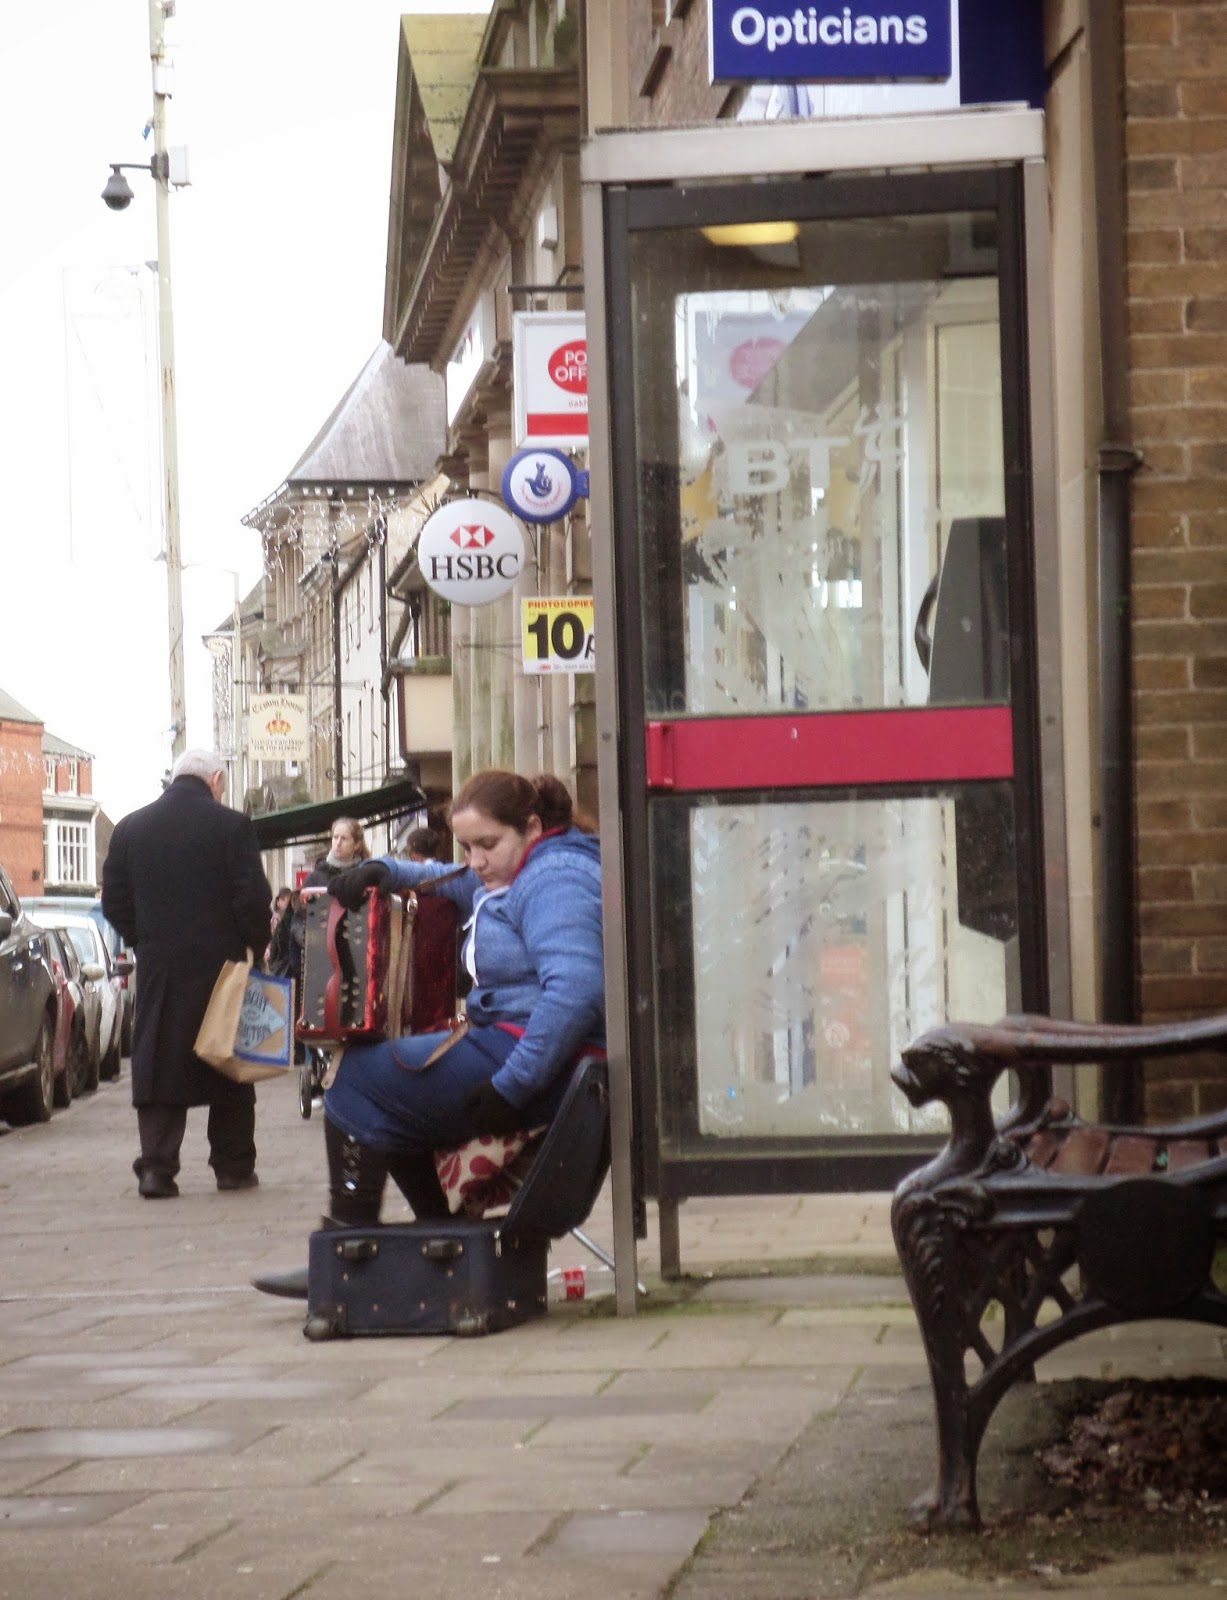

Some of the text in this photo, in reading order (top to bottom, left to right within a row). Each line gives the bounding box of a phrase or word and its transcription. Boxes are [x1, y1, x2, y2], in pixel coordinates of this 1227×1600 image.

[731, 7, 928, 52] Opticians
[729, 436, 849, 493] BT
[430, 553, 519, 581] HSBC
